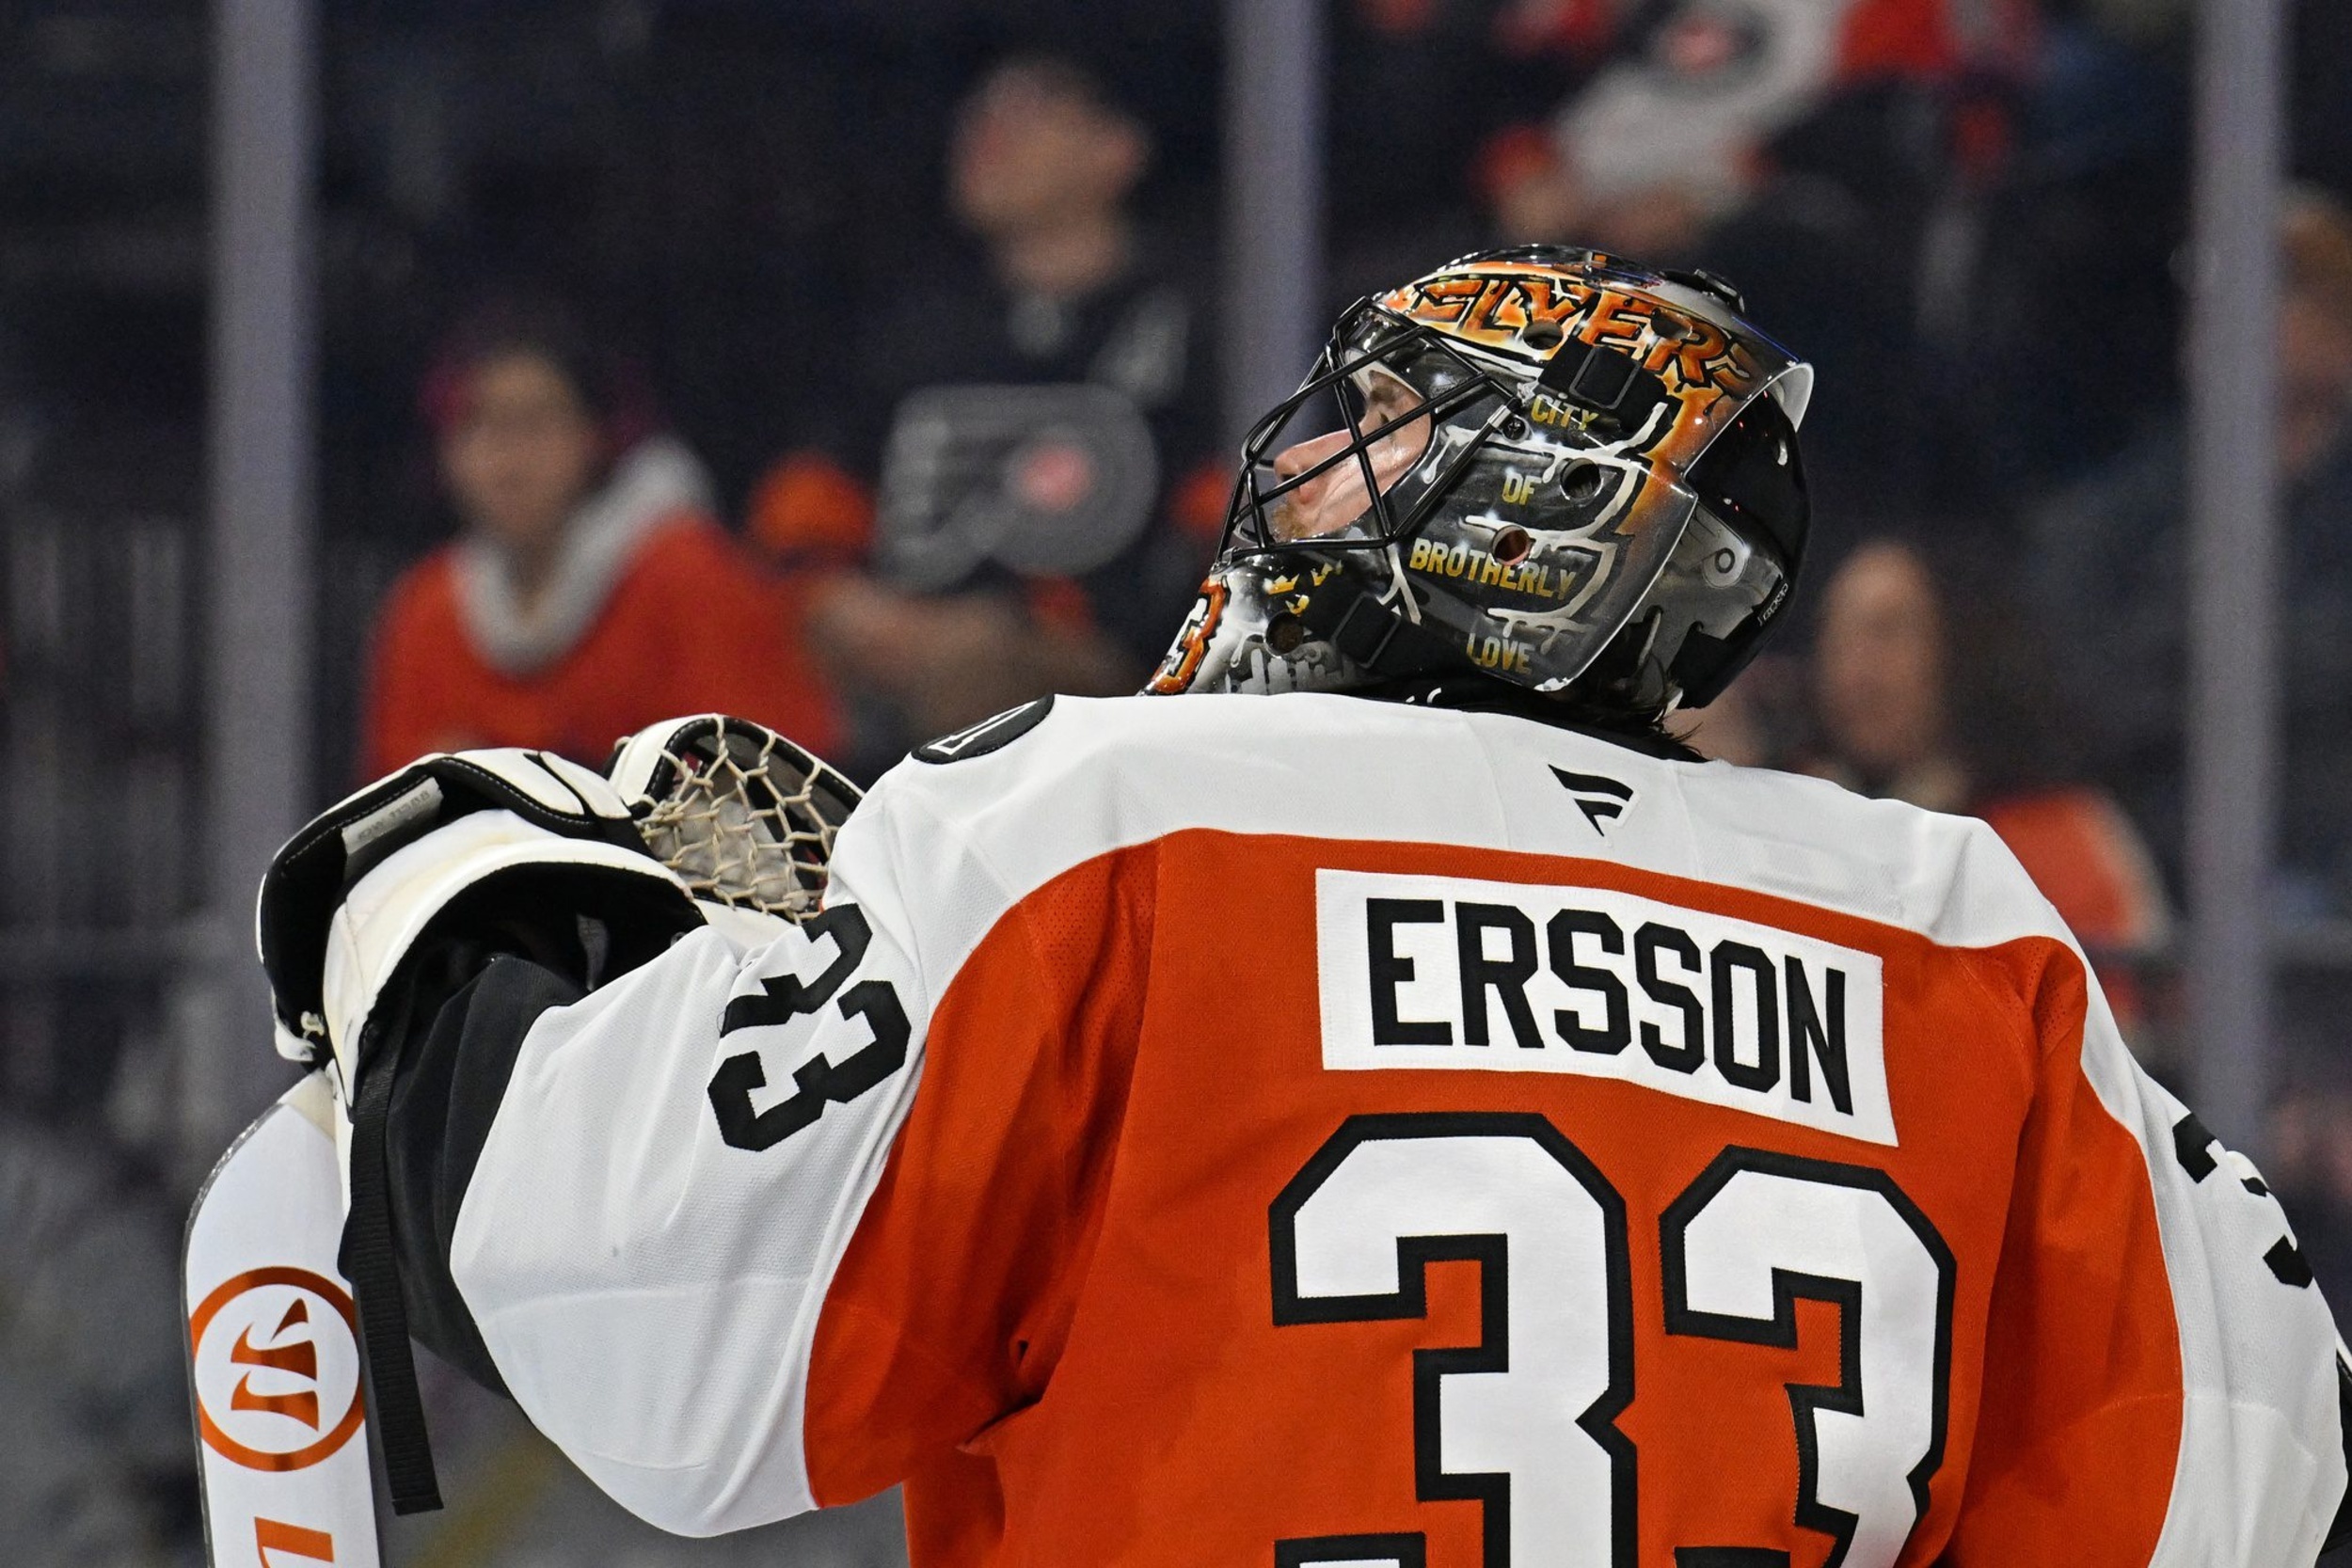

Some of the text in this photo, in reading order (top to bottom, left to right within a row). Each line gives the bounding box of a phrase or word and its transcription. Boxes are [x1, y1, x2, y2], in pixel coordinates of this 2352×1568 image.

[1531, 394, 1599, 431] CITY
[1502, 472, 1543, 505] OF
[1409, 537, 1577, 600] BROTHERLY
[1466, 632, 1535, 674] LOVE
[707, 902, 912, 1152] 33
[1367, 897, 1854, 1117] ERSSON
[1268, 1111, 1959, 1568] 33
